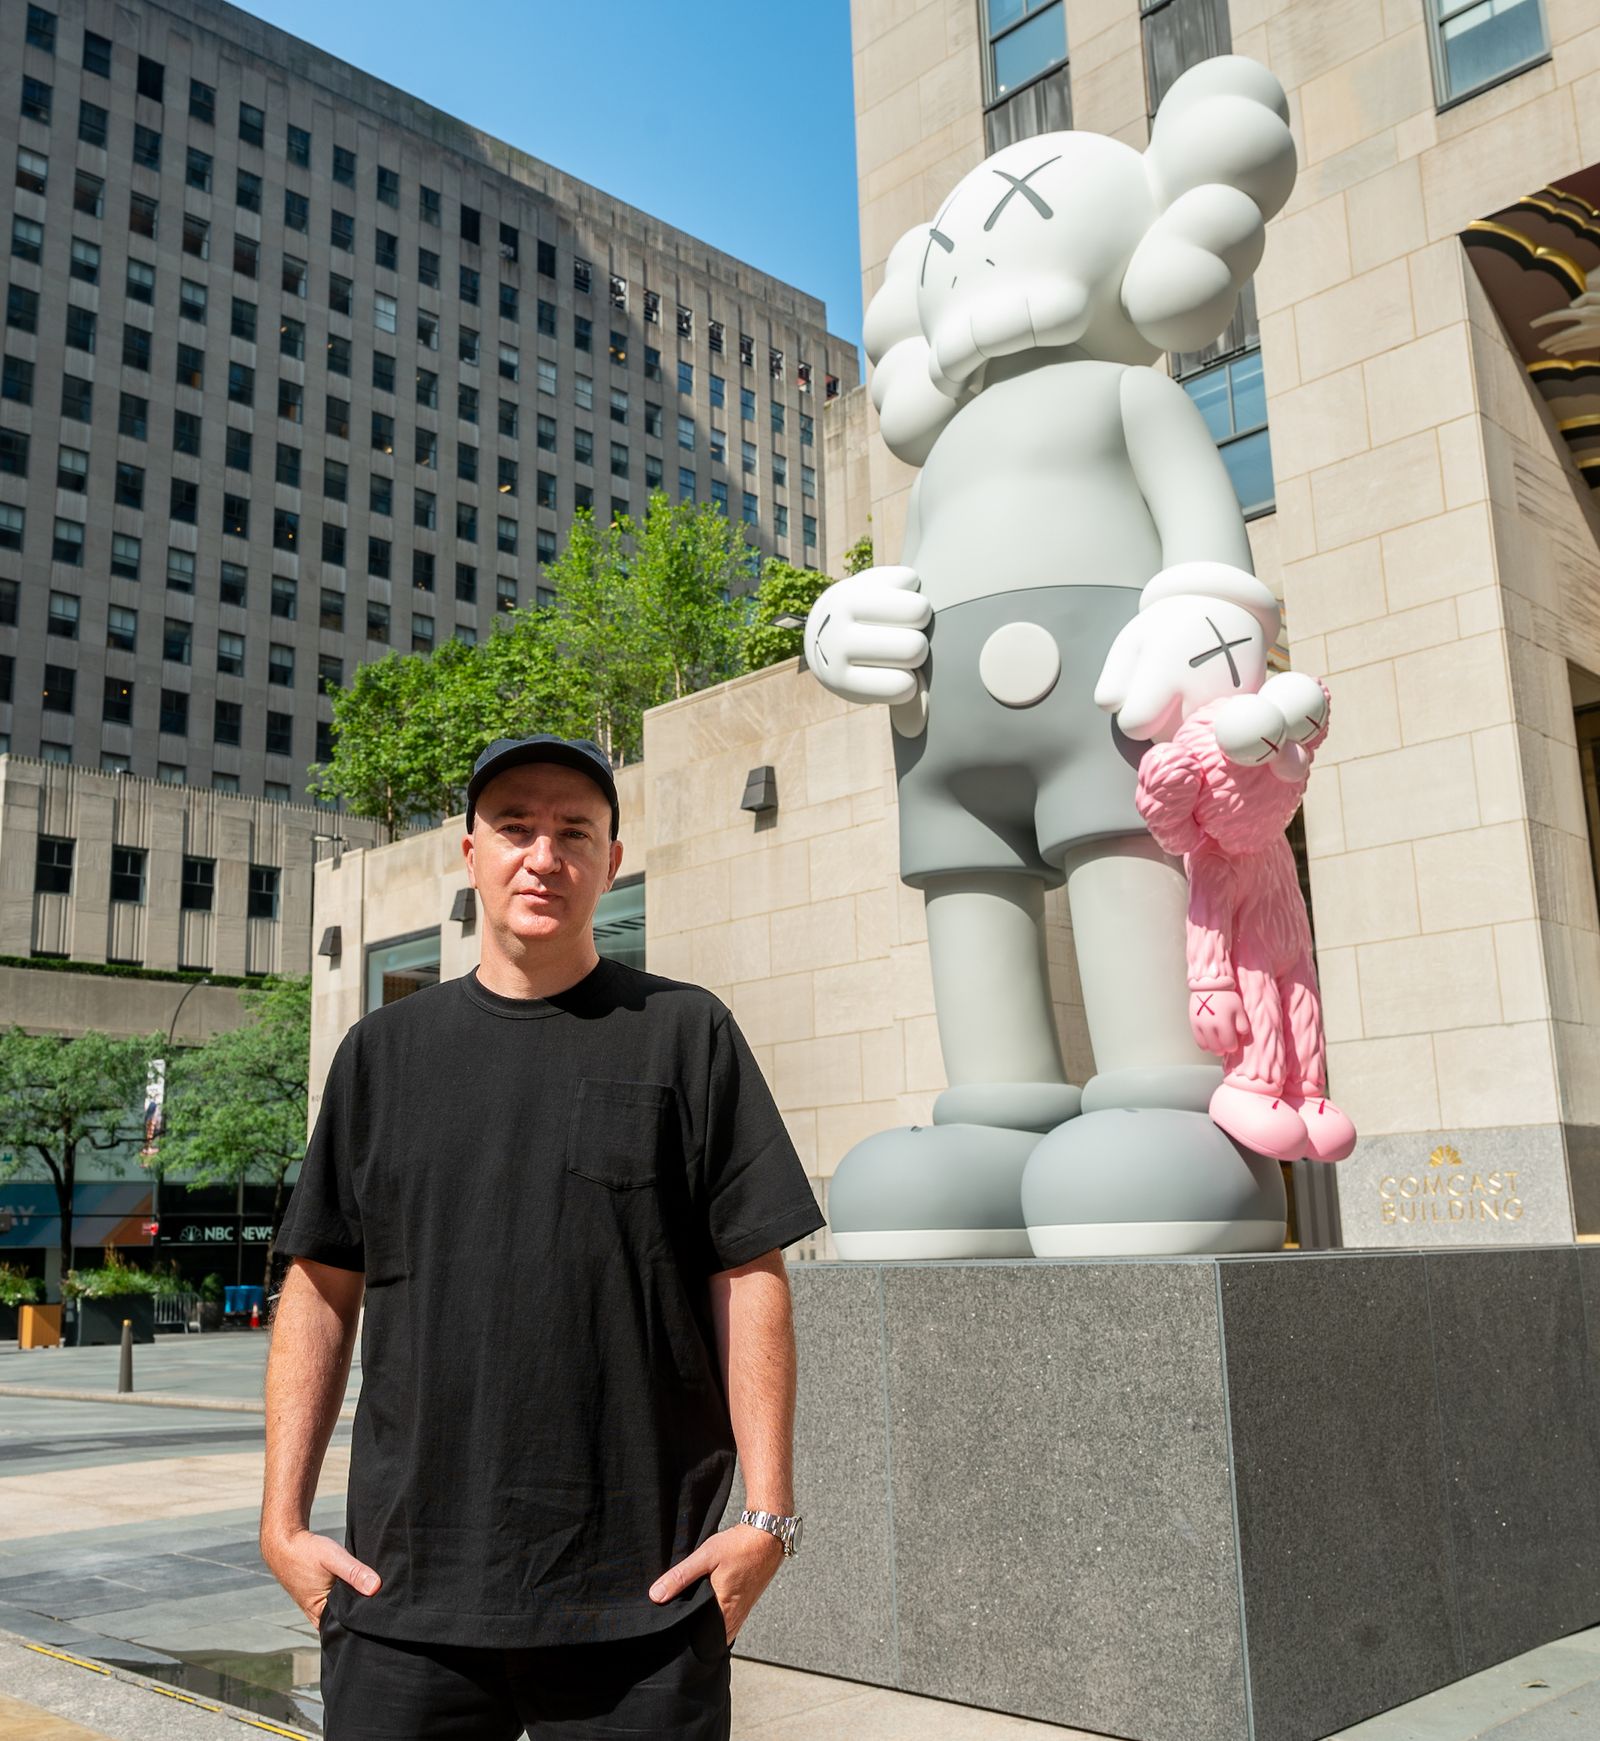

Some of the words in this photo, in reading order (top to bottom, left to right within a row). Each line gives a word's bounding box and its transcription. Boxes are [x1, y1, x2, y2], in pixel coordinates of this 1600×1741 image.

[1380, 1171, 1519, 1198] COMCAST
[0, 1205, 36, 1226] AY
[1382, 1198, 1524, 1224] BUILDING
[204, 1226, 234, 1241] NBC
